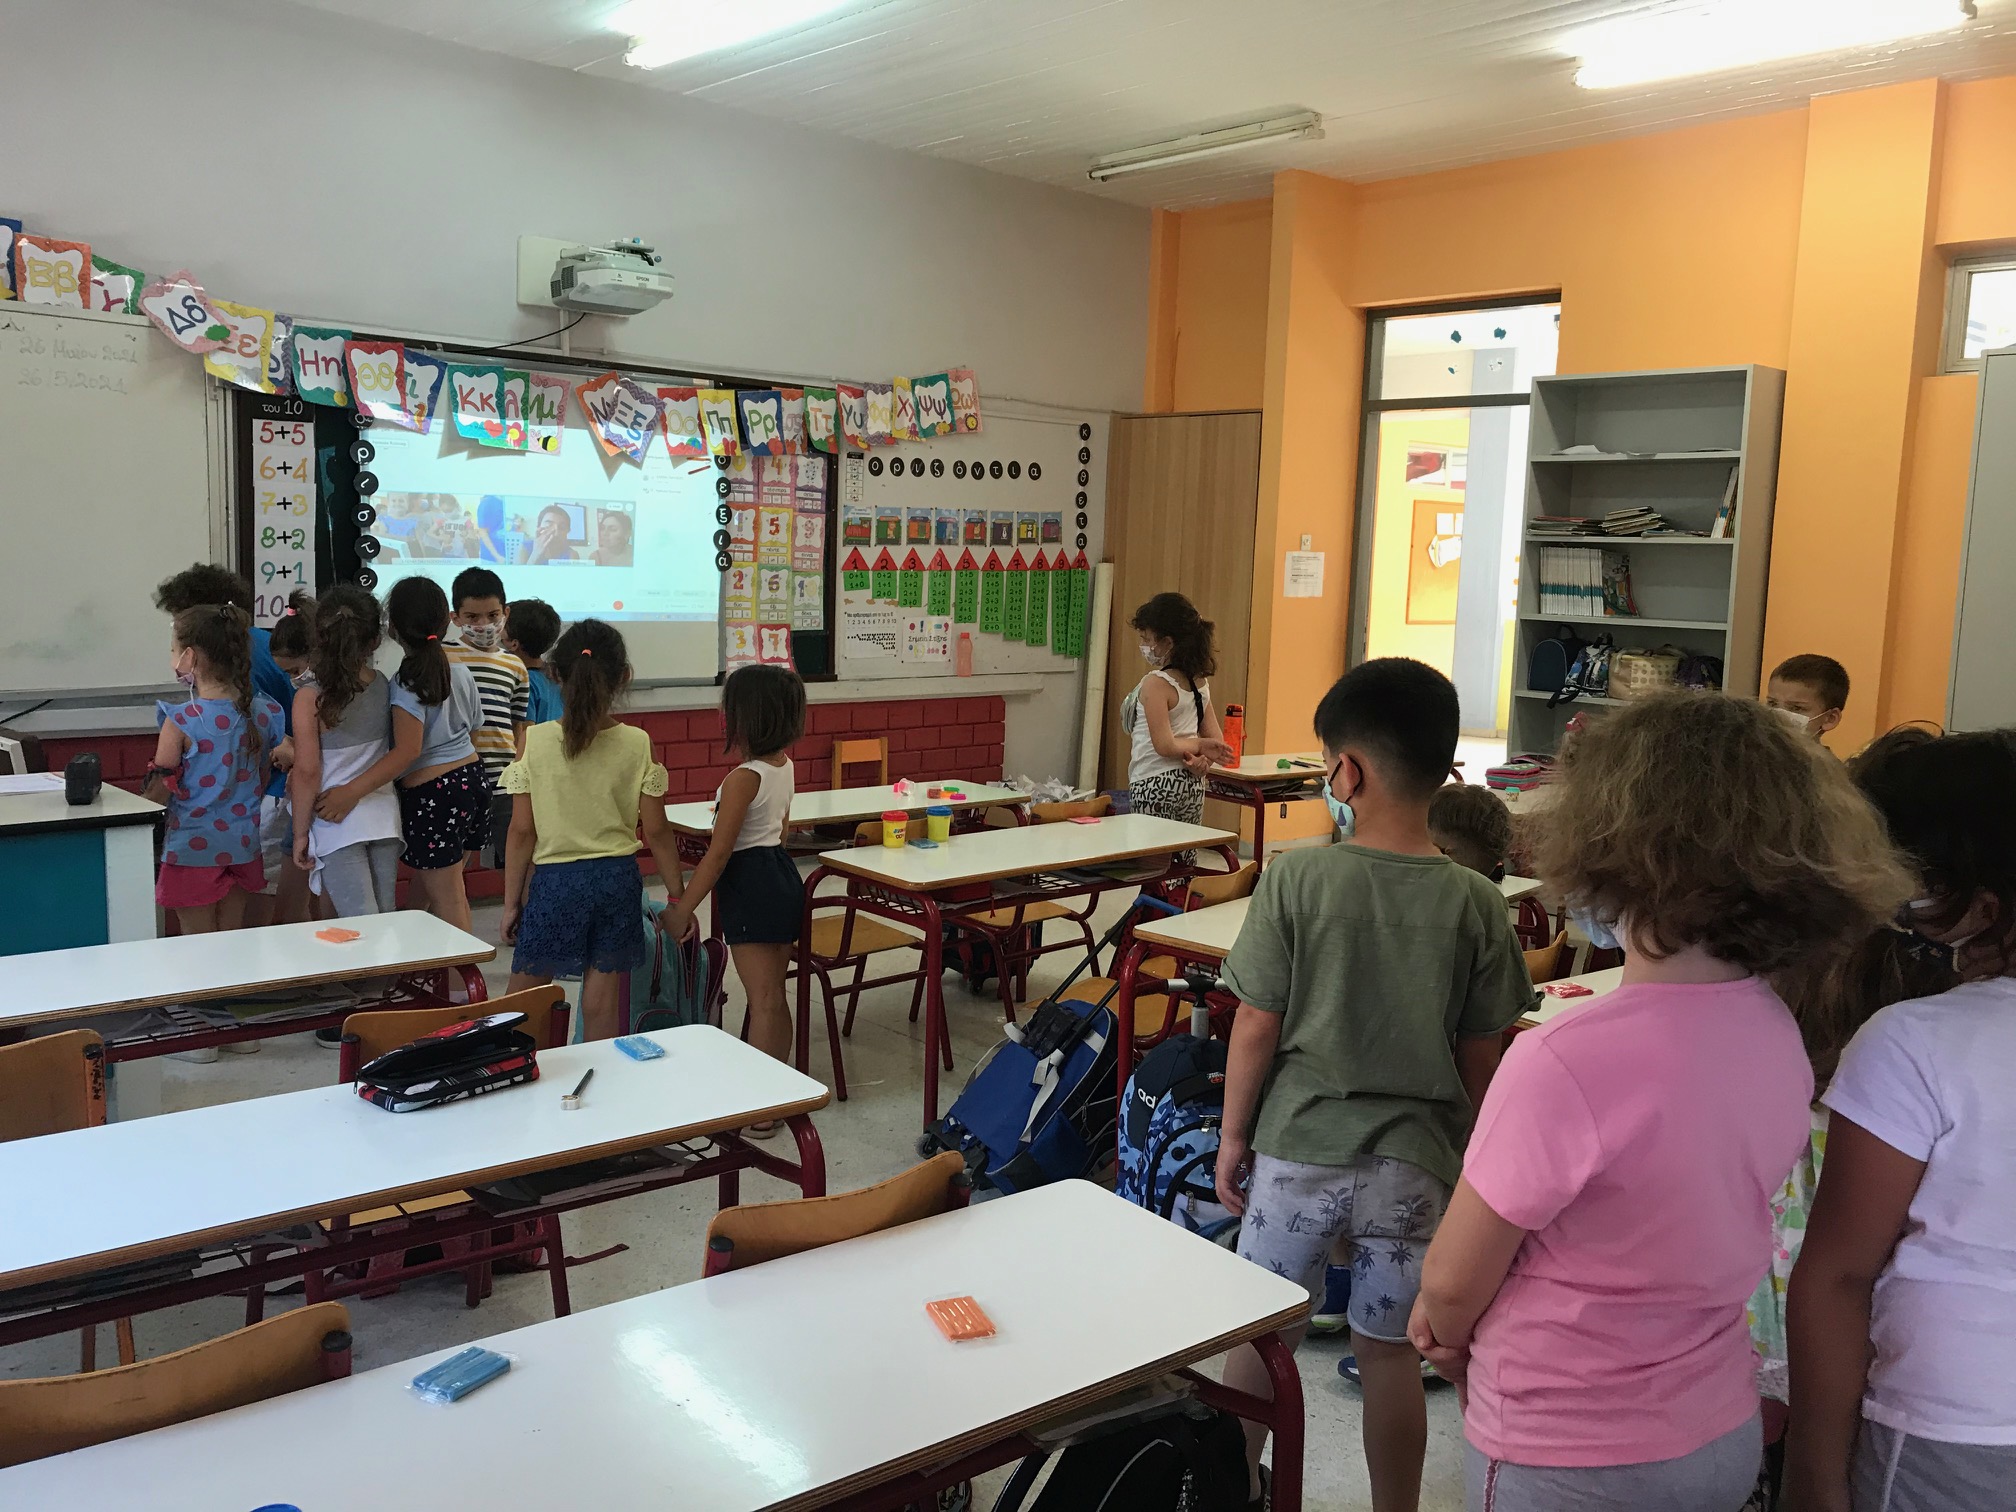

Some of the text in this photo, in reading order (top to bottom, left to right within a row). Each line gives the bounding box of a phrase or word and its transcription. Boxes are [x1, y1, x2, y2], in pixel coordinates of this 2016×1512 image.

[167, 295, 207, 334] Δδ
[102, 344, 138, 363] 2021
[358, 362, 395, 391] Θθ
[262, 400, 303, 414] του 10
[458, 384, 496, 413] Κκ
[918, 395, 947, 420] Ψψ
[706, 410, 733, 435] Ππ
[748, 410, 775, 439] Ρρ
[810, 407, 832, 433] Ττ
[260, 422, 306, 445] 5+5
[260, 456, 308, 482] 6+4
[260, 492, 308, 516] 7+3
[769, 516, 780, 536] 5
[804, 520, 815, 539] 9
[260, 526, 306, 550] 8+2
[260, 561, 307, 584] 9+1
[852, 558, 858, 569] 1
[880, 559, 888, 570] 2
[909, 558, 916, 569] 3
[937, 557, 943, 570] 4
[963, 558, 970, 568] 5
[989, 560, 996, 570] 6
[1013, 560, 1020, 570] 7
[1037, 559, 1044, 569] 8
[732, 570, 744, 590] 2
[768, 574, 780, 594] 6
[797, 580, 817, 598] 10
[735, 630, 746, 648] 3
[768, 634, 780, 652] 7
